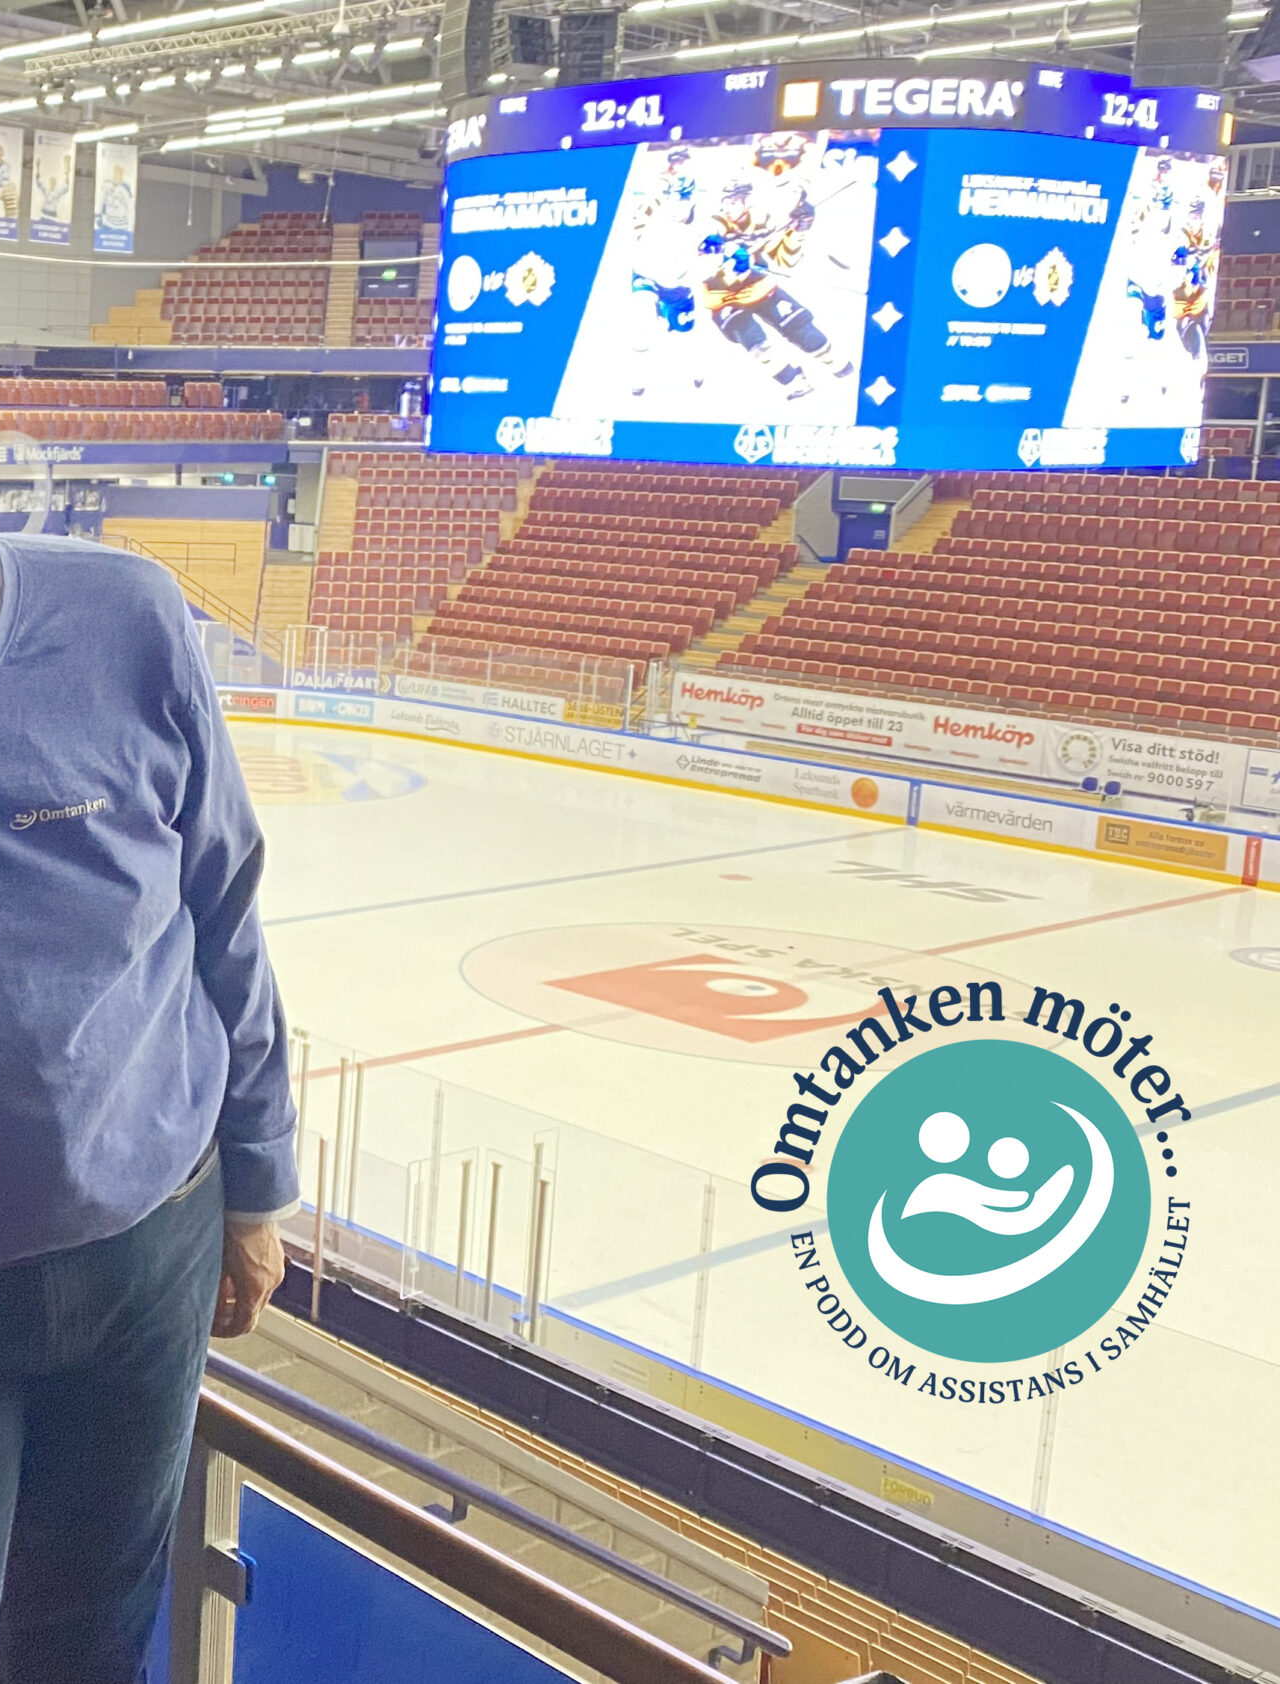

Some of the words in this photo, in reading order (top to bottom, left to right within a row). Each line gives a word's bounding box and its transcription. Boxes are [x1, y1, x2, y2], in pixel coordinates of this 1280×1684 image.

[581, 95, 664, 132] 12:41
[1101, 93, 1159, 130] 12:41
[501, 695, 557, 716] HALLTEC
[680, 682, 765, 711] Hemköp
[791, 706, 823, 722] Alltid
[827, 711, 864, 731] öppet
[866, 715, 883, 730] till
[887, 719, 904, 733] 23
[933, 715, 1035, 749] Hemköp
[503, 727, 626, 761] STJÄRNLAGET
[1111, 737, 1143, 754] Visa
[1147, 743, 1176, 759] ditt
[1178, 747, 1221, 765] stöd!
[690, 764, 762, 784] Entreprenad
[691, 756, 721, 768] Linde
[1108, 755, 1140, 767] Swisha
[1141, 759, 1175, 772] valfritt
[1175, 763, 1208, 779] belopp
[1209, 767, 1224, 779] till
[39, 797, 107, 822] Omtanken
[945, 801, 1054, 833] värmevärden
